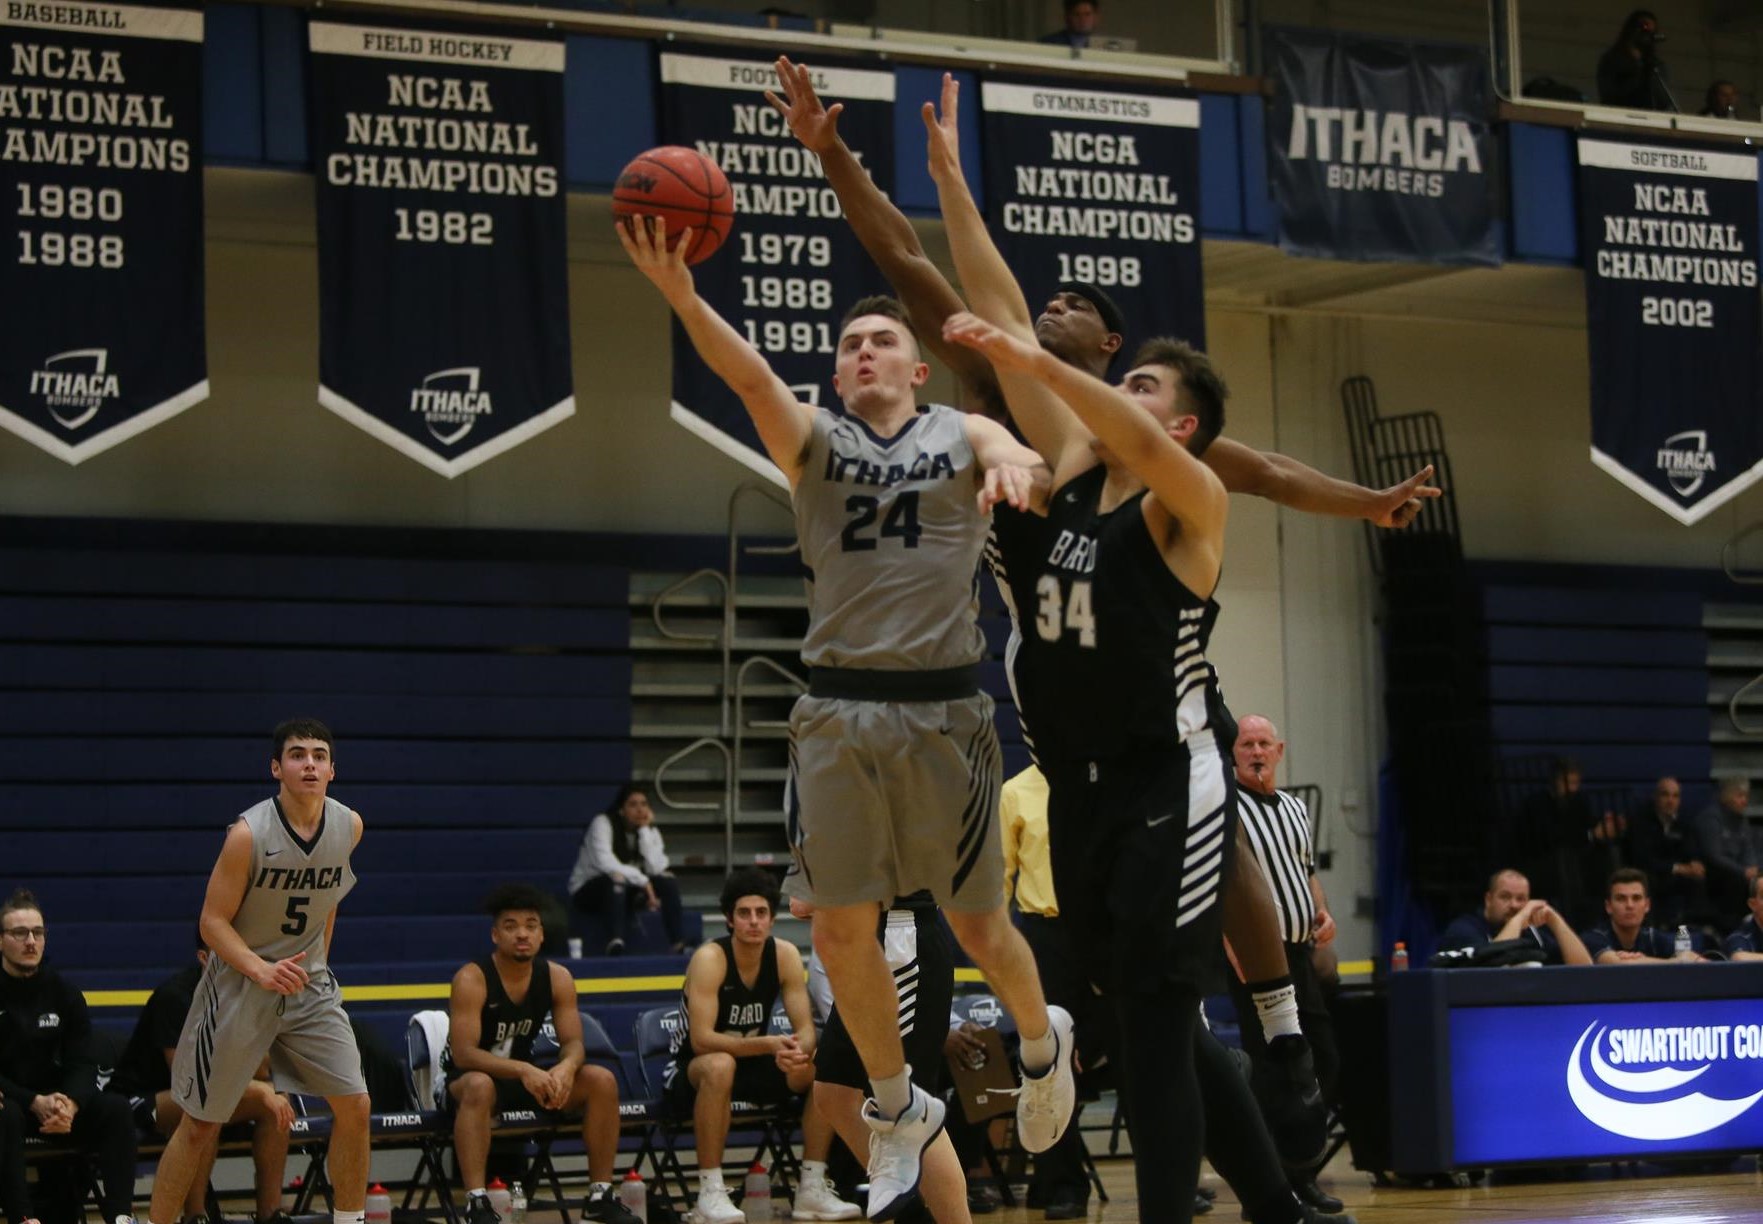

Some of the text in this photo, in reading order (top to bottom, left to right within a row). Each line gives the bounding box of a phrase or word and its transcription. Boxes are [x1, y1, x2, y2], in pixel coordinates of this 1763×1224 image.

[7, 2, 127, 29] BASEBALL
[11, 42, 125, 84] NCAA
[363, 33, 513, 61] FIELD HOCKEY
[387, 74, 493, 113] NCAA
[730, 66, 829, 90] FOOTL
[0, 84, 173, 129] ATIONAL
[732, 104, 791, 138] NC
[1033, 93, 1152, 118] GYMNASTICS
[2, 127, 190, 173] AMPIONS
[345, 112, 538, 156] NATIONAL
[1051, 130, 1139, 166] NCGA
[1289, 103, 1482, 174] ITHACA
[327, 153, 558, 198] CHAMPIONS
[694, 140, 872, 181] NATION
[1631, 150, 1708, 171] SOFTBALL
[1015, 165, 1177, 205] NATIONAL
[1326, 164, 1444, 198] BOMBERS
[17, 182, 122, 221] 1980
[1633, 183, 1710, 216] NCAA
[395, 207, 493, 245] 1982
[1003, 202, 1195, 243] CHAMPIONS
[1604, 215, 1744, 252] NATIONAL
[18, 231, 124, 268] 1988
[740, 232, 831, 267] 1979
[1057, 253, 1142, 287] 1998
[1597, 249, 1759, 288] CHAMPIONS
[742, 276, 833, 310] 1988
[1642, 297, 1714, 328] 2002
[744, 319, 835, 353] 1991
[30, 371, 119, 397] ITHACA
[410, 388, 492, 414] ITHACA
[824, 449, 955, 488] ITHACA
[1657, 449, 1717, 471] ITHACA
[841, 490, 922, 552] 24
[1036, 574, 1097, 649] 34
[254, 866, 342, 890] ITHACA
[281, 896, 310, 936] 5
[729, 1003, 763, 1025] BARD
[1608, 1024, 1763, 1064] SWARTHOUT CO
[382, 1115, 422, 1127] ITHACA
[502, 1110, 536, 1121] THACA
